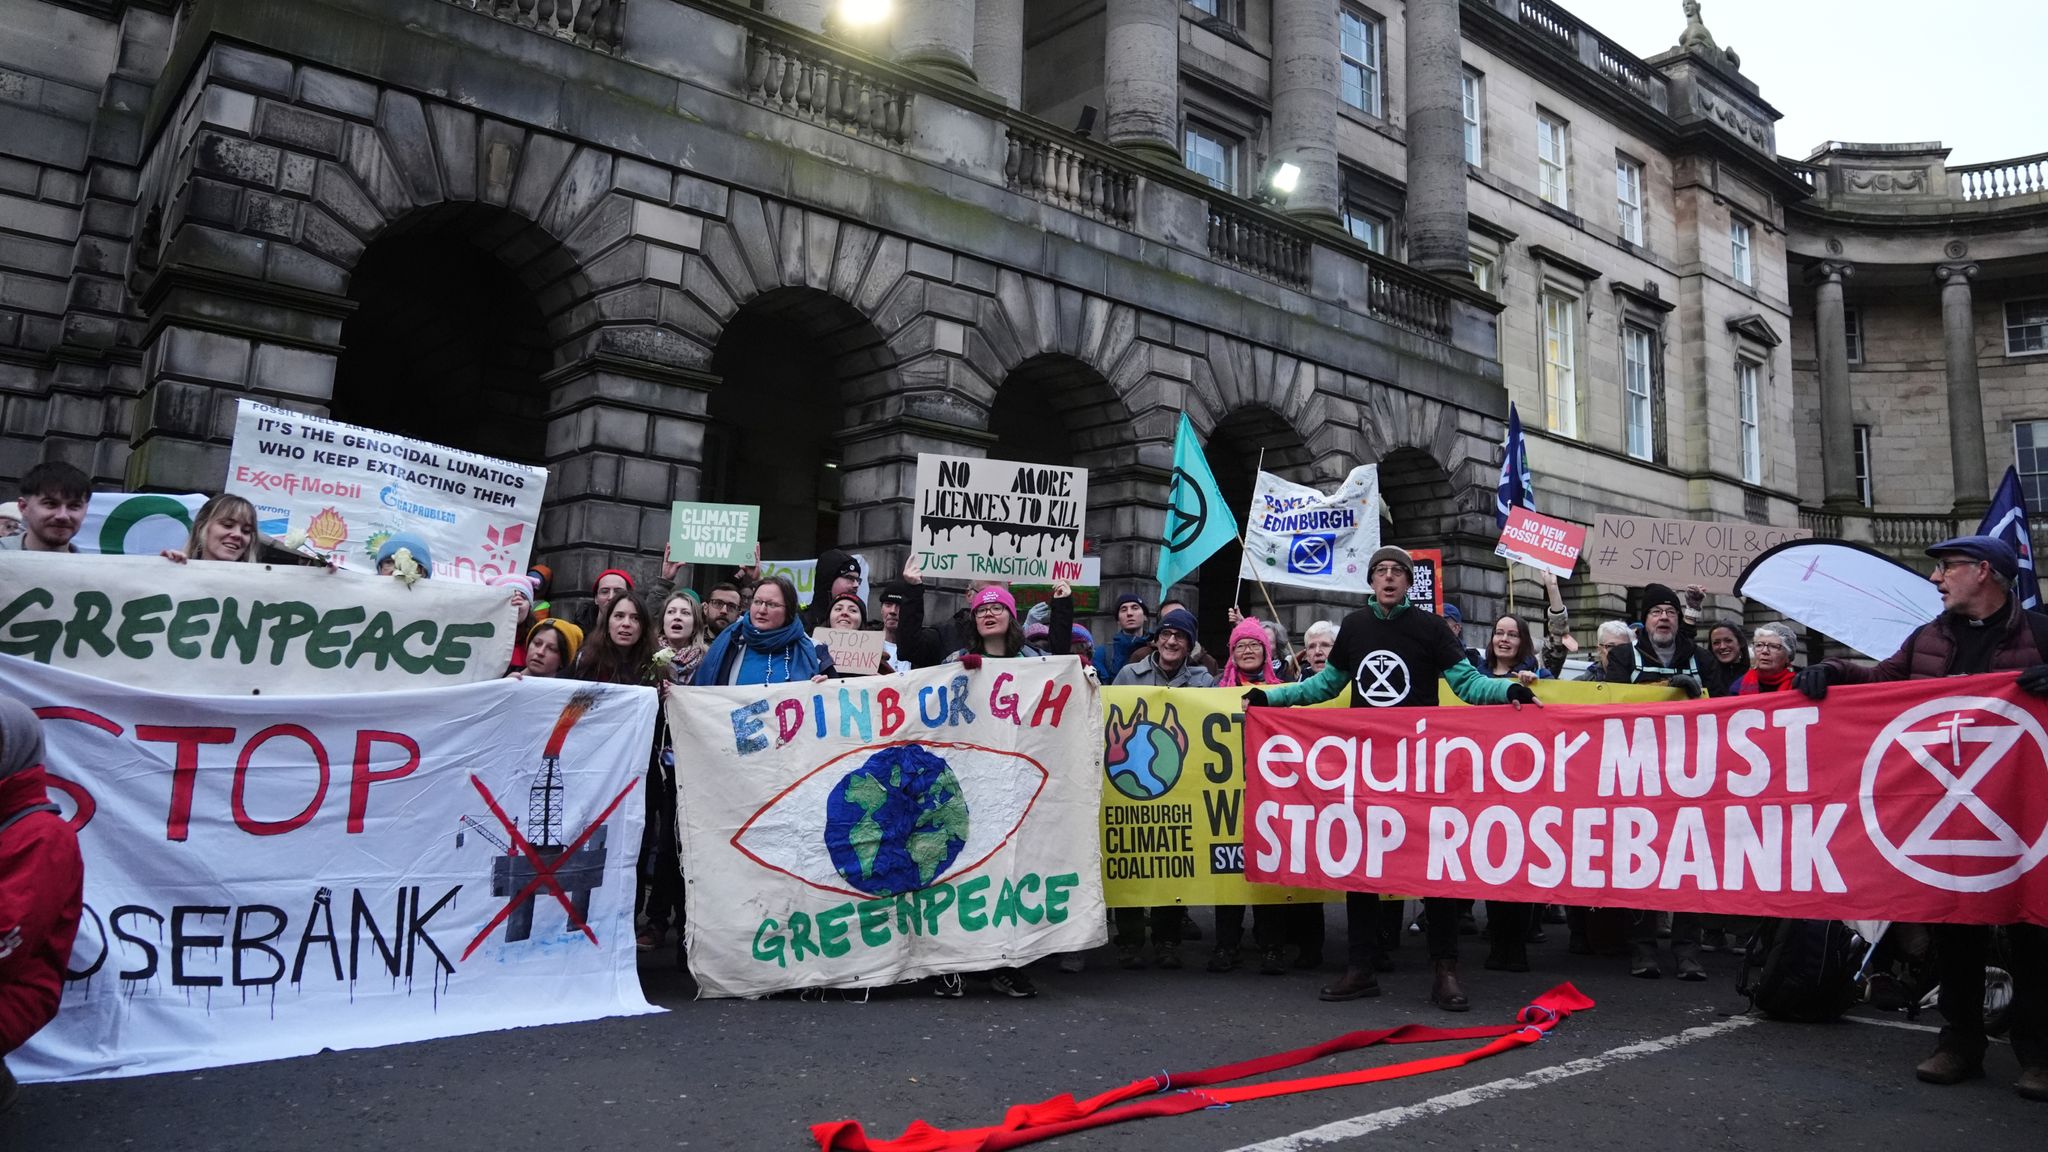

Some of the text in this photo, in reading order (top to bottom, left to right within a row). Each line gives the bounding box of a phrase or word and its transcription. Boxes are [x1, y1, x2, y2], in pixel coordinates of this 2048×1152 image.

[252, 402, 297, 418] FOSSIL
[257, 417, 525, 489] IT'S THE GENOCIDAL LUNATICS
[258, 440, 517, 508] WHO KEEP EXTRACTING THEM
[938, 460, 1074, 497] NO MORE
[681, 508, 750, 527] CLIMATE
[923, 489, 1080, 528] LICENCES TO KILL
[1262, 509, 1355, 533] EDINBURGH
[680, 524, 747, 543] JUSTICE
[1502, 525, 1540, 547] FOSSIL
[1540, 537, 1580, 560] FUELS!
[1521, 518, 1567, 542] NO NEW
[1602, 519, 1636, 540] NO
[1651, 521, 1696, 547] NEW
[693, 541, 732, 559] NOW
[1630, 547, 1684, 574] STOP
[917, 551, 959, 571] JUST
[1052, 560, 1083, 580] NOW
[0, 587, 495, 675] GREENPEACE
[827, 630, 871, 649] STOP
[730, 672, 1073, 757] EDINBURGH
[1257, 706, 1820, 805] equinor MUST
[1105, 803, 1193, 825] EDINBURGH
[1105, 825, 1194, 854] CLIMATE
[1255, 800, 1848, 894] STOP ROSEBANK
[1106, 855, 1195, 880] COALITION
[751, 872, 1081, 968] GREENPEACE
[65, 885, 463, 990] OSEBANK
